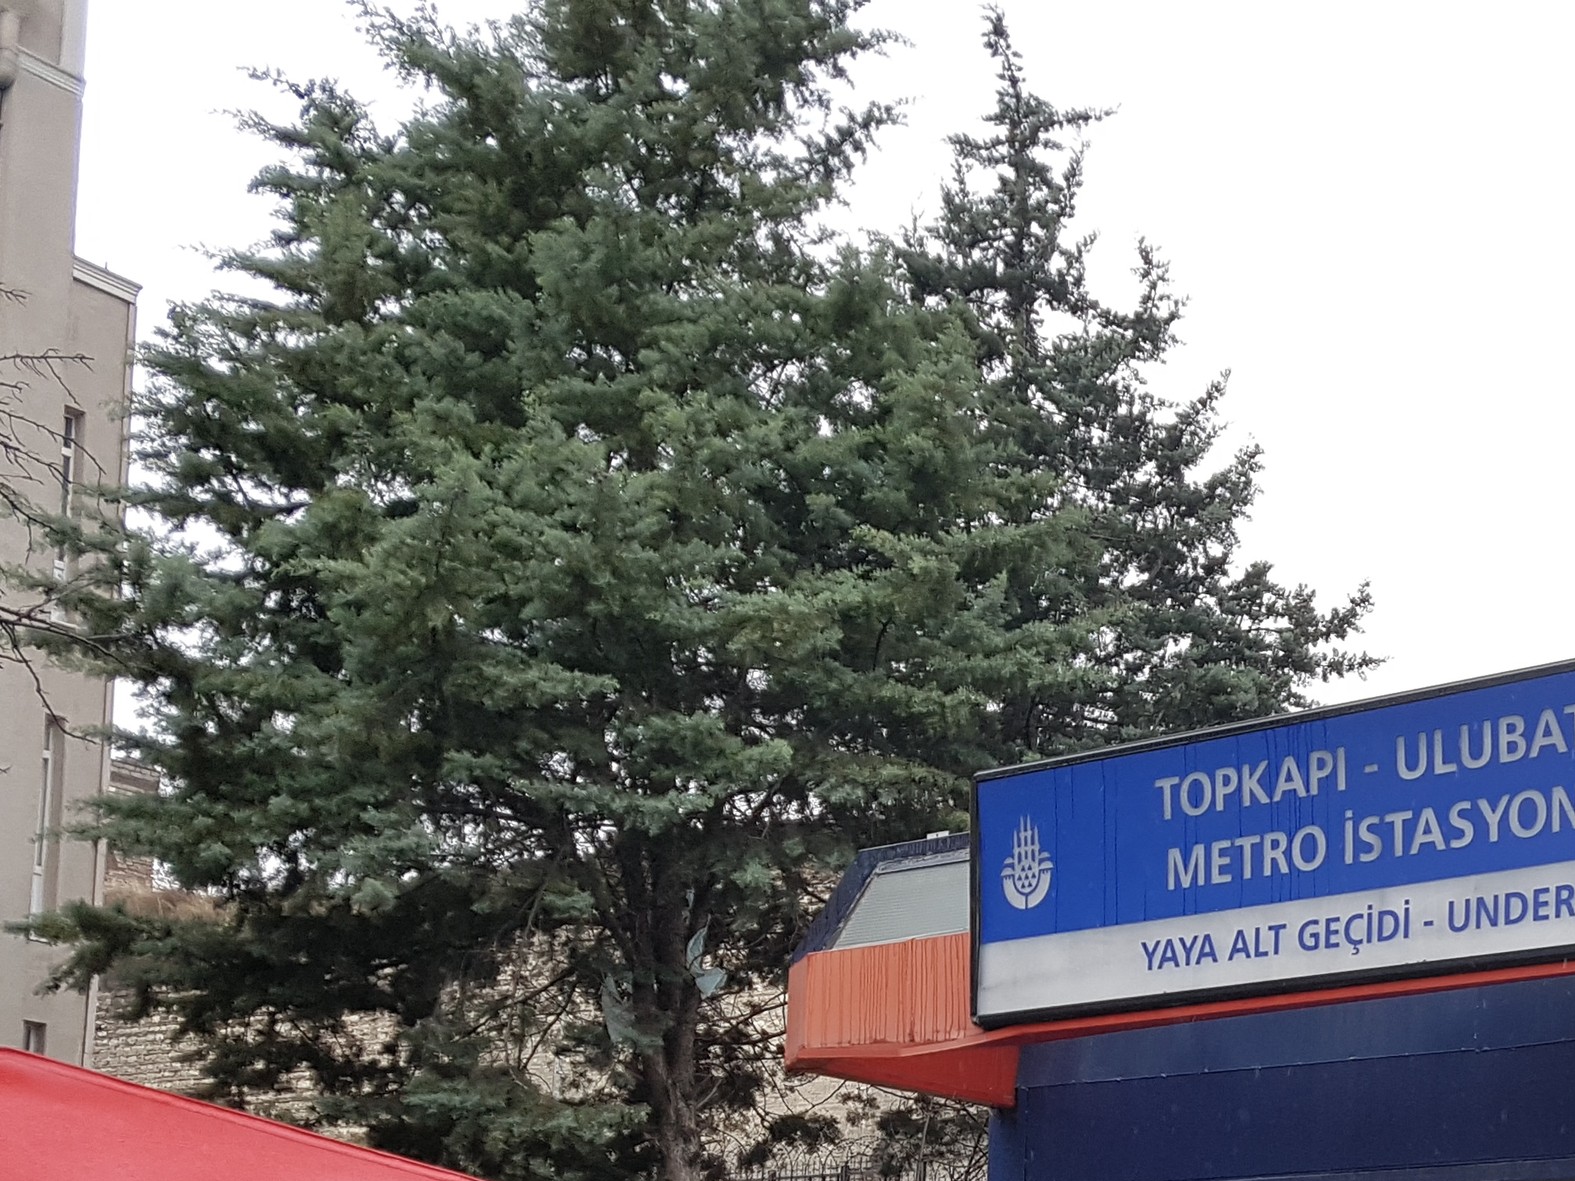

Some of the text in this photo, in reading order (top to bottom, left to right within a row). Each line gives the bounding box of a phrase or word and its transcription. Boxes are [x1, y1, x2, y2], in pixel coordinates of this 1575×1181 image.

[1154, 746, 1347, 821] TOPKAPI
[1166, 824, 1328, 891] METRO
[1140, 932, 1219, 972] YAYA
[1226, 922, 1288, 962] ALT
[1297, 898, 1411, 956] GEÇİDİ
